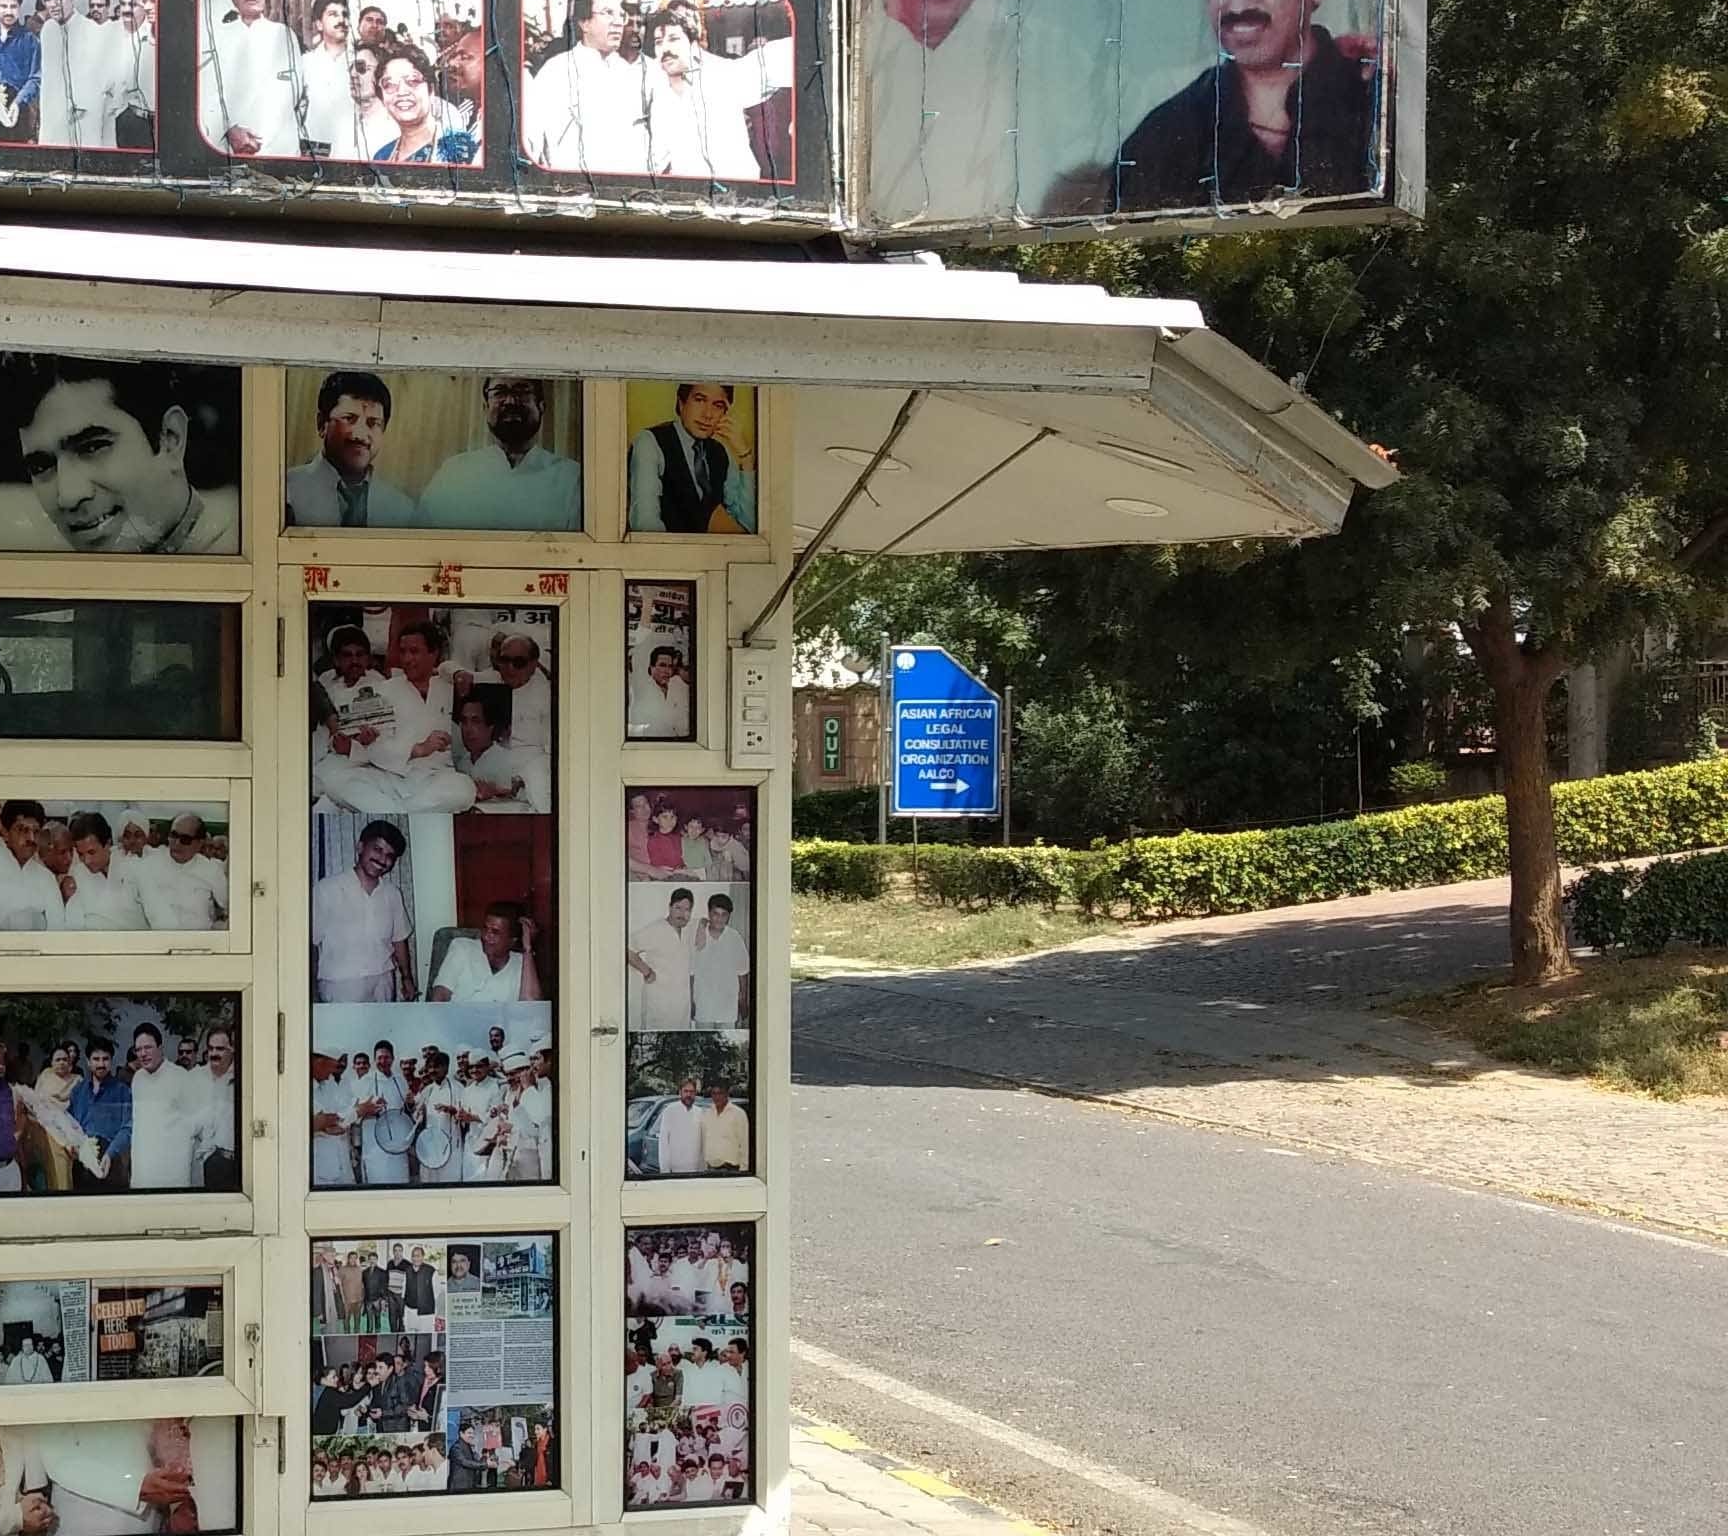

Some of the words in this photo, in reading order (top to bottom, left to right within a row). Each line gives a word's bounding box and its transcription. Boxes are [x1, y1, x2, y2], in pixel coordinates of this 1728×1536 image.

[900, 708, 937, 719] ASIAN
[939, 708, 992, 719] AFRICAN
[926, 723, 966, 735] LEGAL
[825, 719, 839, 769] OUT
[904, 739, 989, 750] CONSULTATIVE
[901, 753, 989, 765] ORGANIZATION
[918, 768, 955, 779] AALCO
[103, 1317, 129, 1334] HERE
